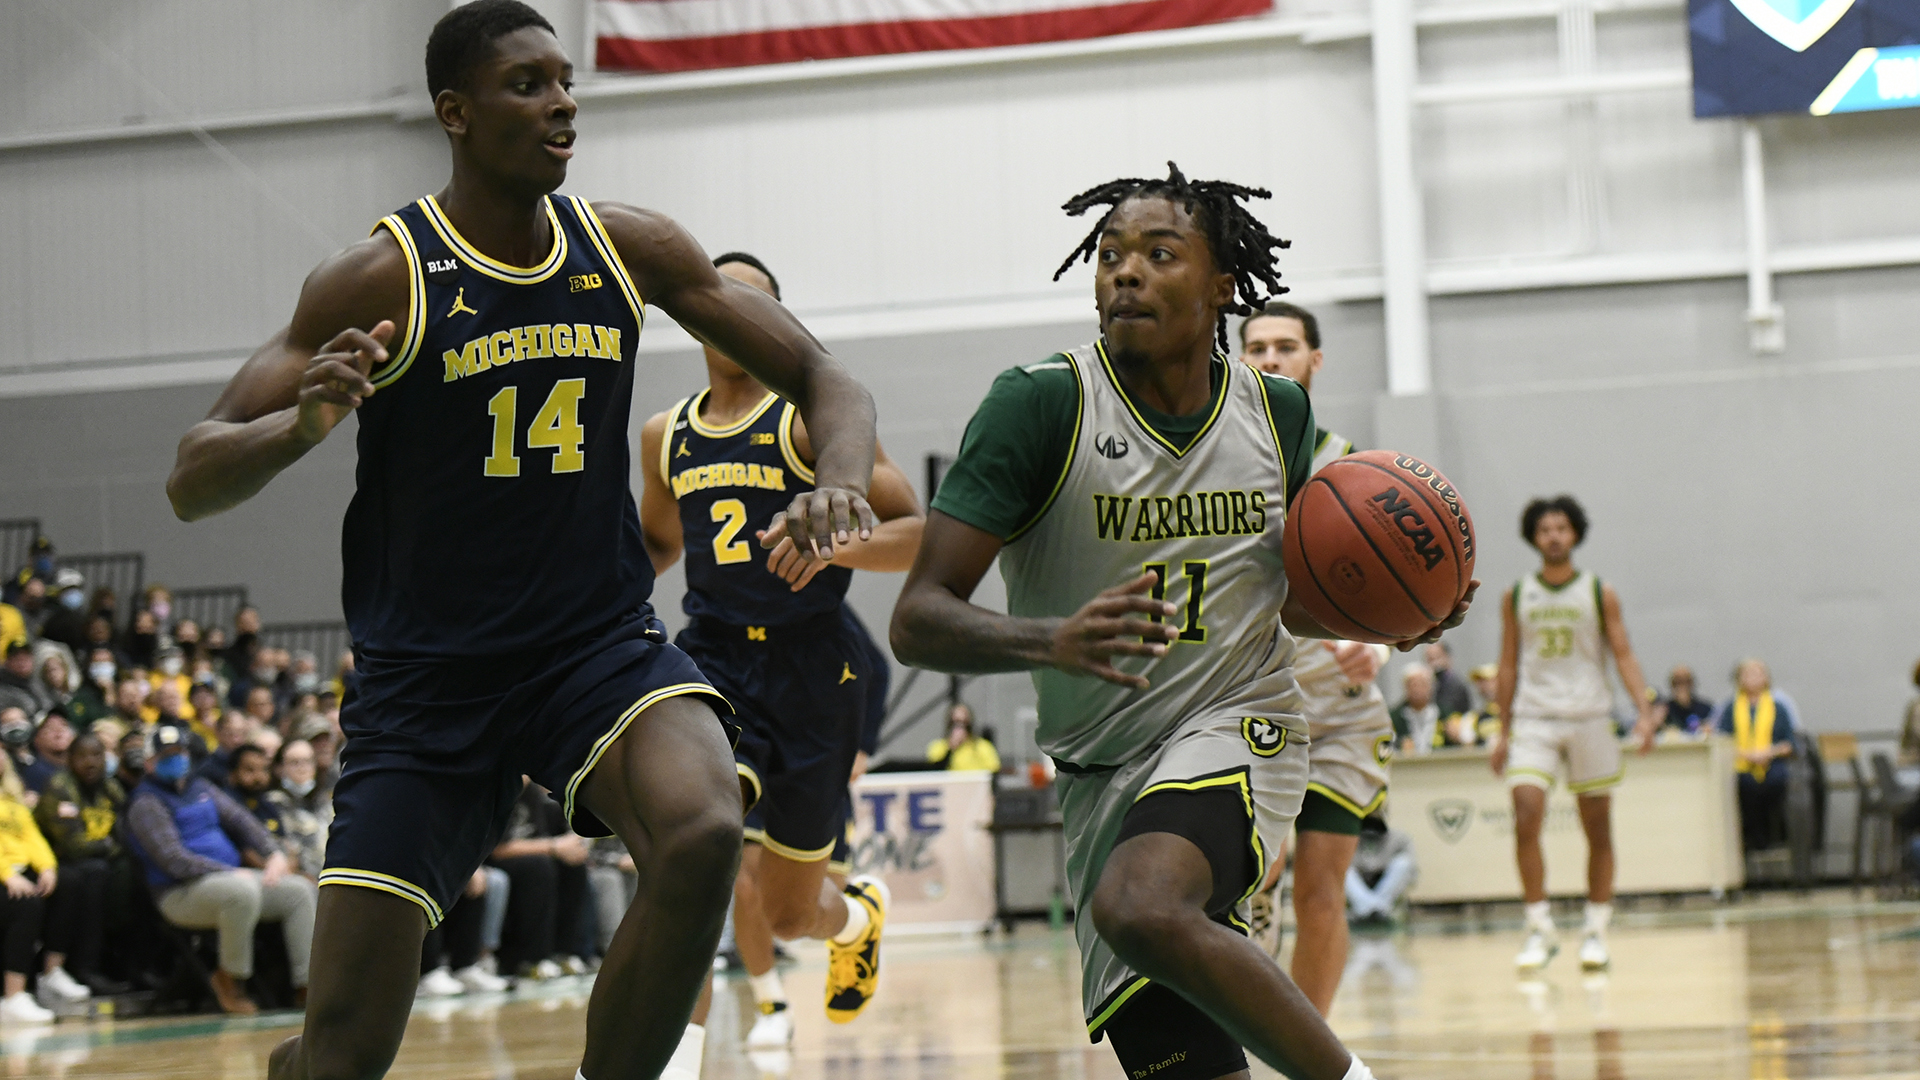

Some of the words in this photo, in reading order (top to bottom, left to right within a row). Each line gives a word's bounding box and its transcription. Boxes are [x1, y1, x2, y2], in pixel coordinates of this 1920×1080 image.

[427, 259, 458, 273] BLM
[442, 323, 622, 383] MICHIGAN
[484, 378, 586, 477] 14
[671, 462, 786, 500] MICHIGAN
[710, 498, 752, 565] 2
[1092, 490, 1267, 542] WARRIORS
[1373, 487, 1446, 572] NCAA
[860, 790, 942, 832] TE
[1133, 1069, 1147, 1080] The
[1149, 1051, 1187, 1074] Family
